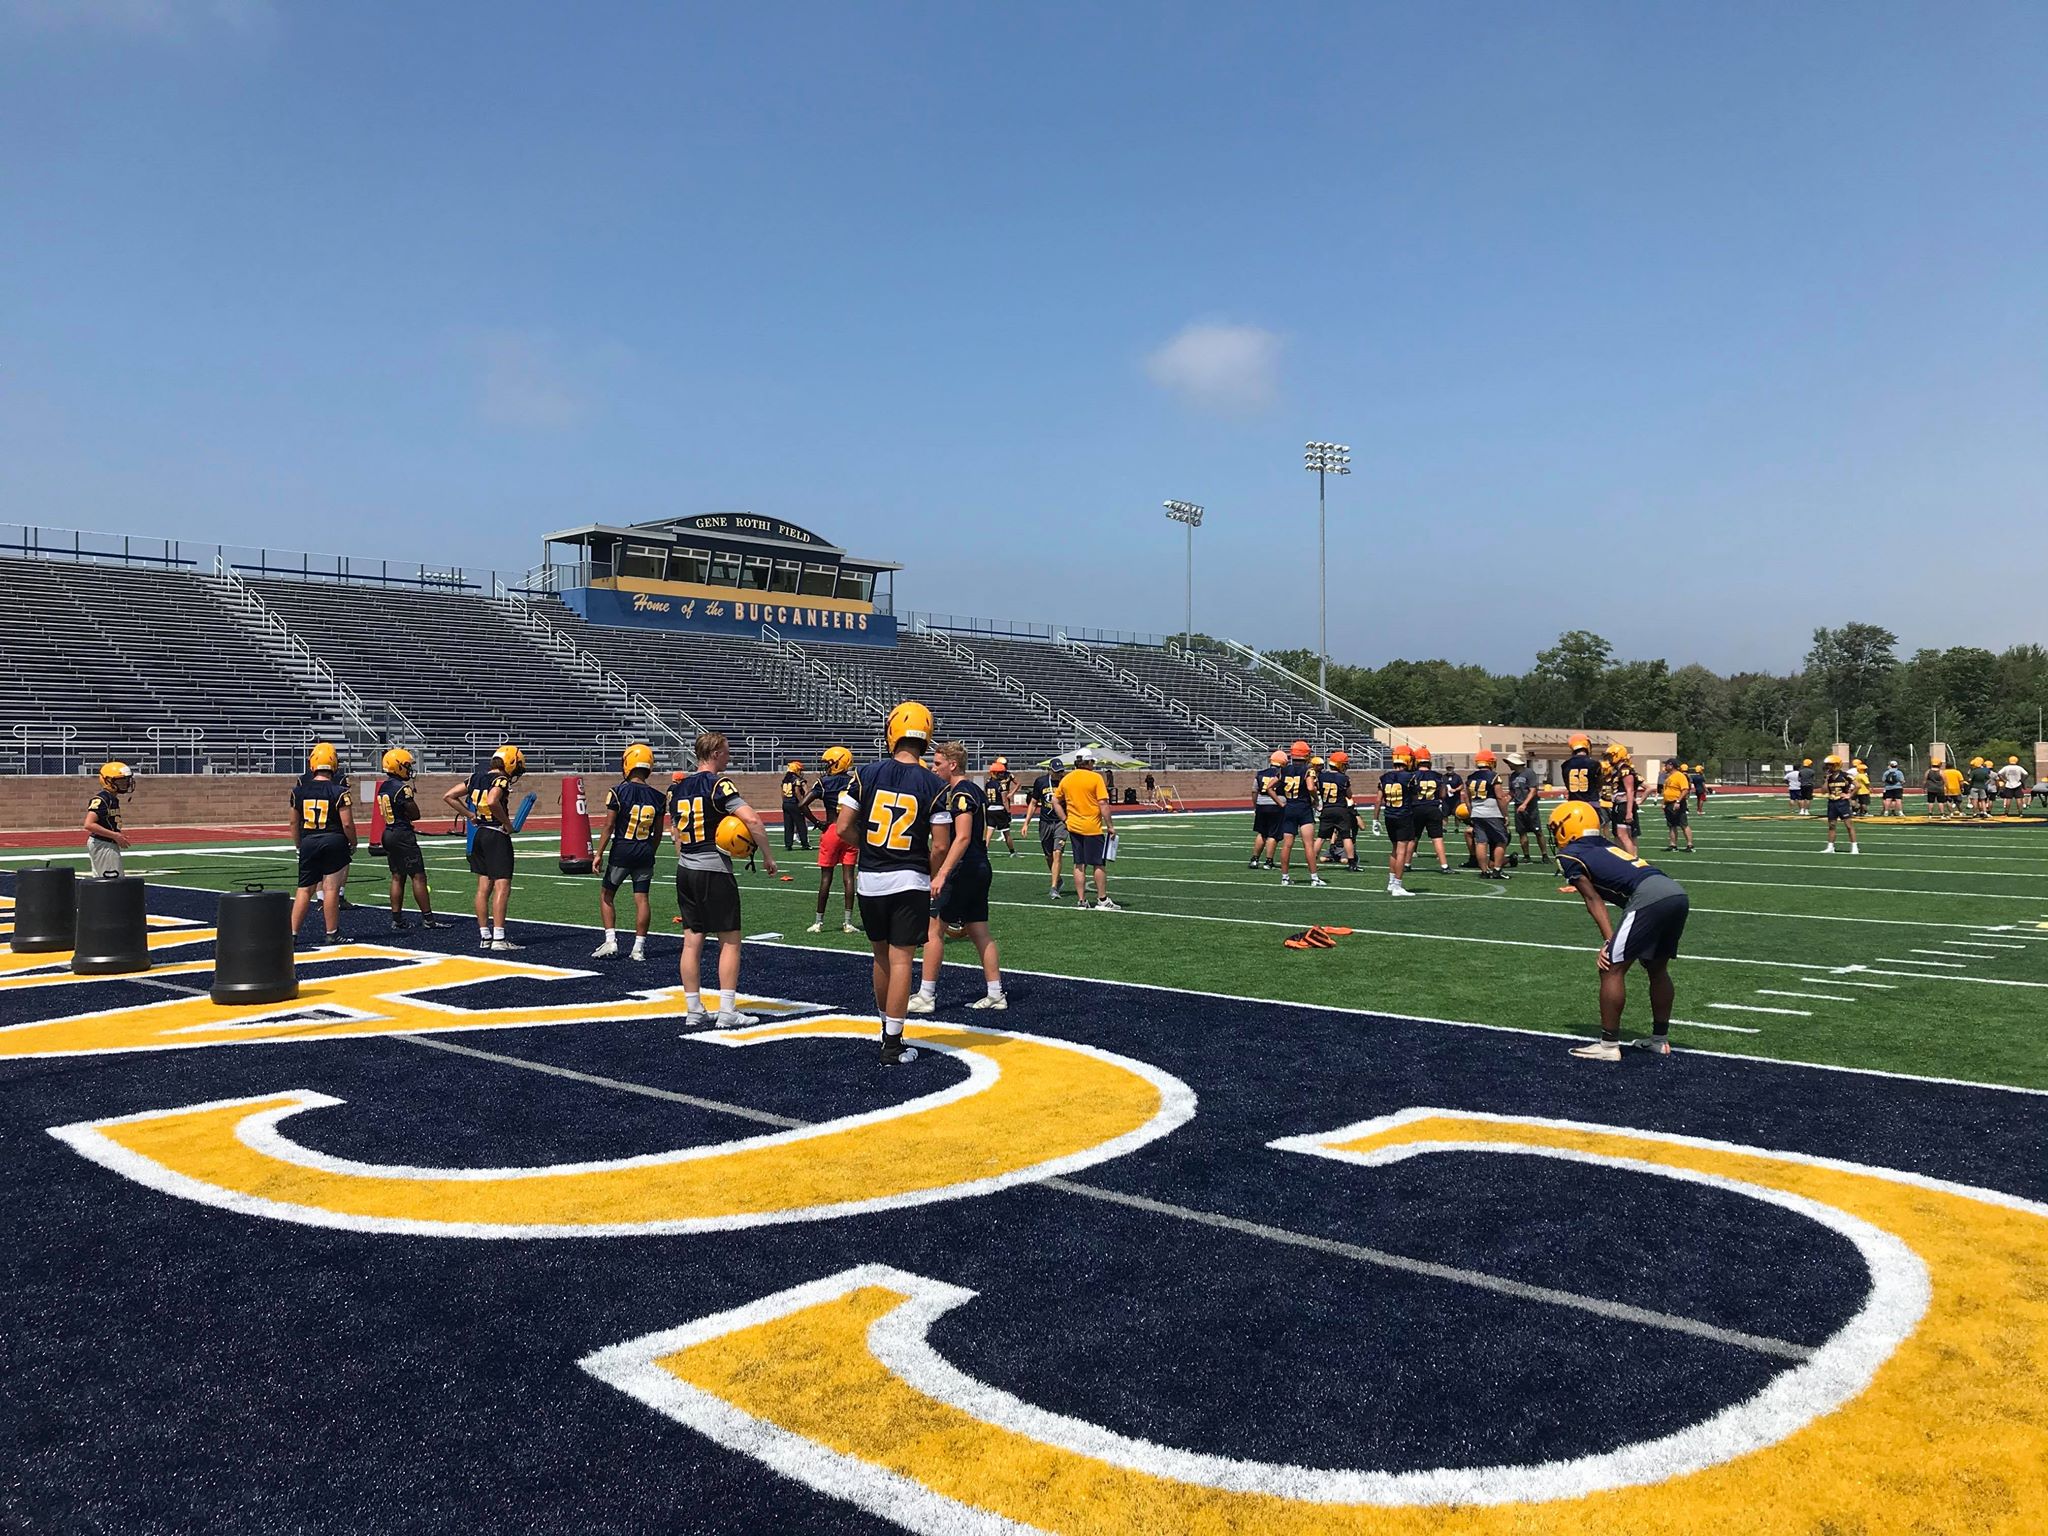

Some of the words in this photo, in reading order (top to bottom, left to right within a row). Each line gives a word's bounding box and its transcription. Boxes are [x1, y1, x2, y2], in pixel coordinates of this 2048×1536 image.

[695, 517, 727, 528] GENE
[735, 517, 771, 531] ROTHI
[778, 524, 811, 543] FIELD
[633, 593, 670, 612] Home
[681, 600, 695, 619] of
[705, 601, 724, 616] the
[735, 602, 867, 630] BUCCANEERS
[302, 799, 329, 830] 57
[624, 804, 655, 841] 18
[676, 796, 706, 844] 21
[866, 789, 918, 851] 52
